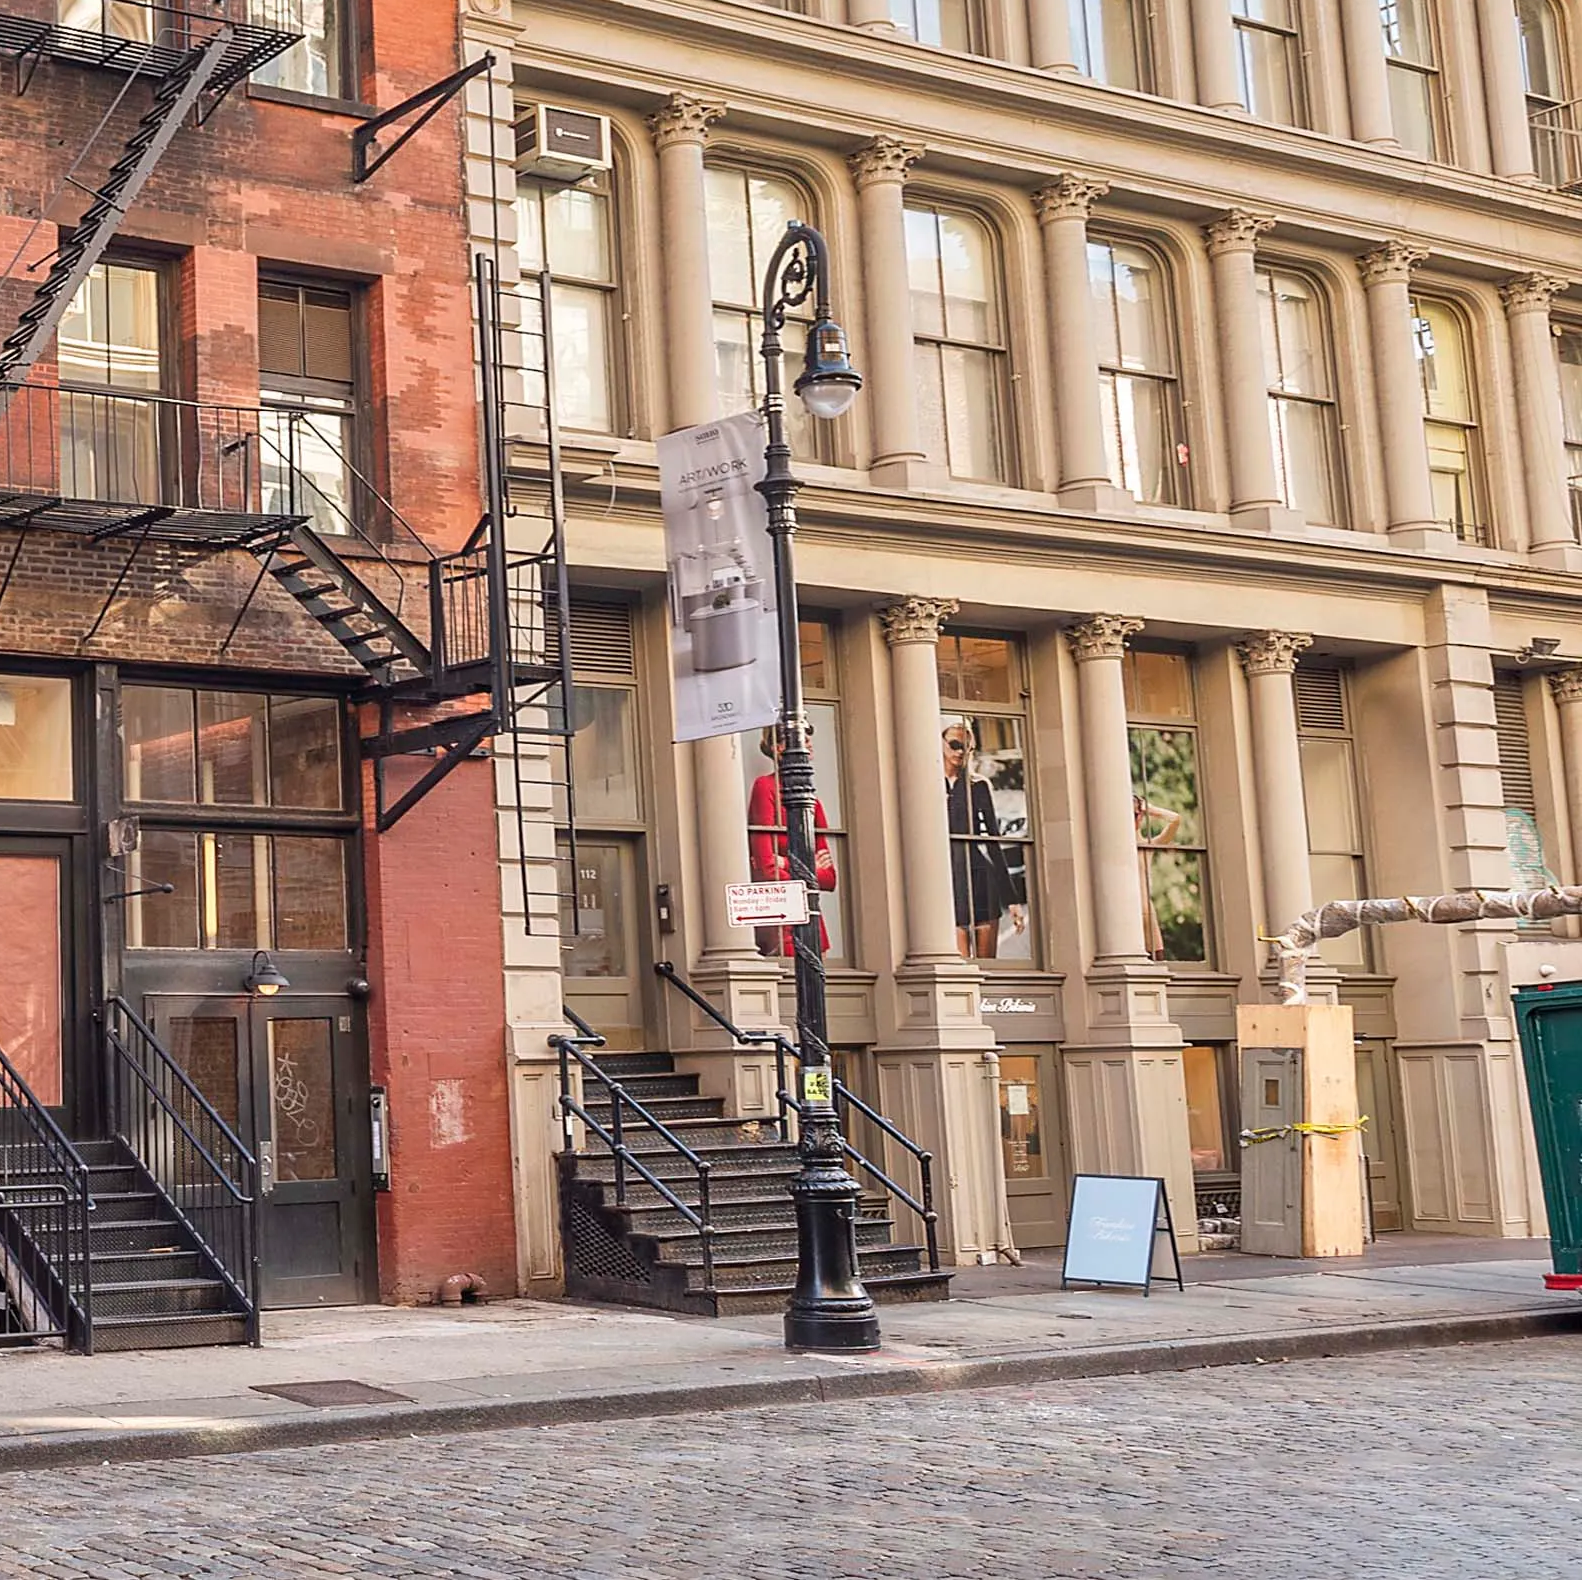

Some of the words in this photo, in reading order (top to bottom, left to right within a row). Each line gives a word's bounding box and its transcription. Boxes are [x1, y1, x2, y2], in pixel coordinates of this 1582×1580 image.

[679, 458, 748, 485] ART/WORK
[580, 869, 597, 880] 112
[731, 888, 745, 896] NO
[747, 886, 786, 896] PARKING
